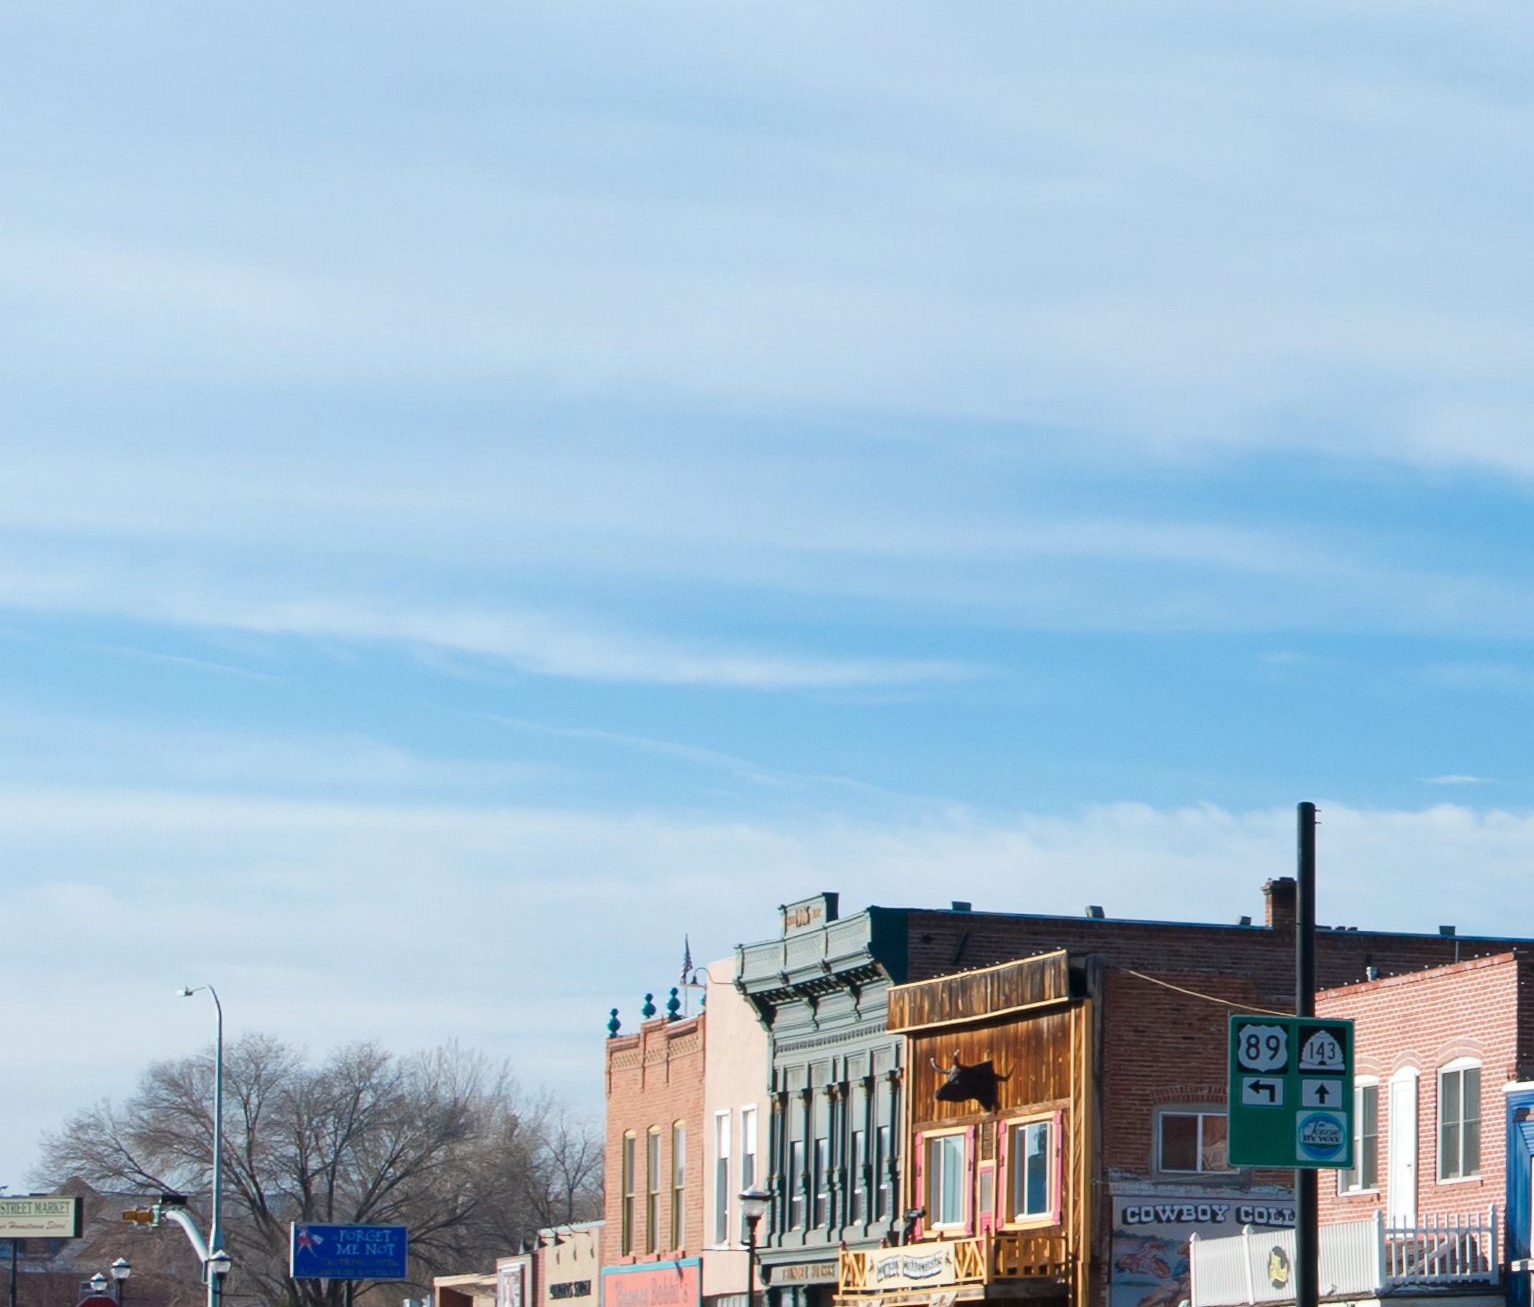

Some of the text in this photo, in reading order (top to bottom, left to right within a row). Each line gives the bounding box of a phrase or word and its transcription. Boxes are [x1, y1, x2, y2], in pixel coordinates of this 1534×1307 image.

[1245, 1034, 1336, 1061] 89 143
[1122, 1204, 1296, 1226] COWBOY COLL
[339, 1229, 392, 1243] FORGET
[335, 1243, 396, 1256] ME NOT
